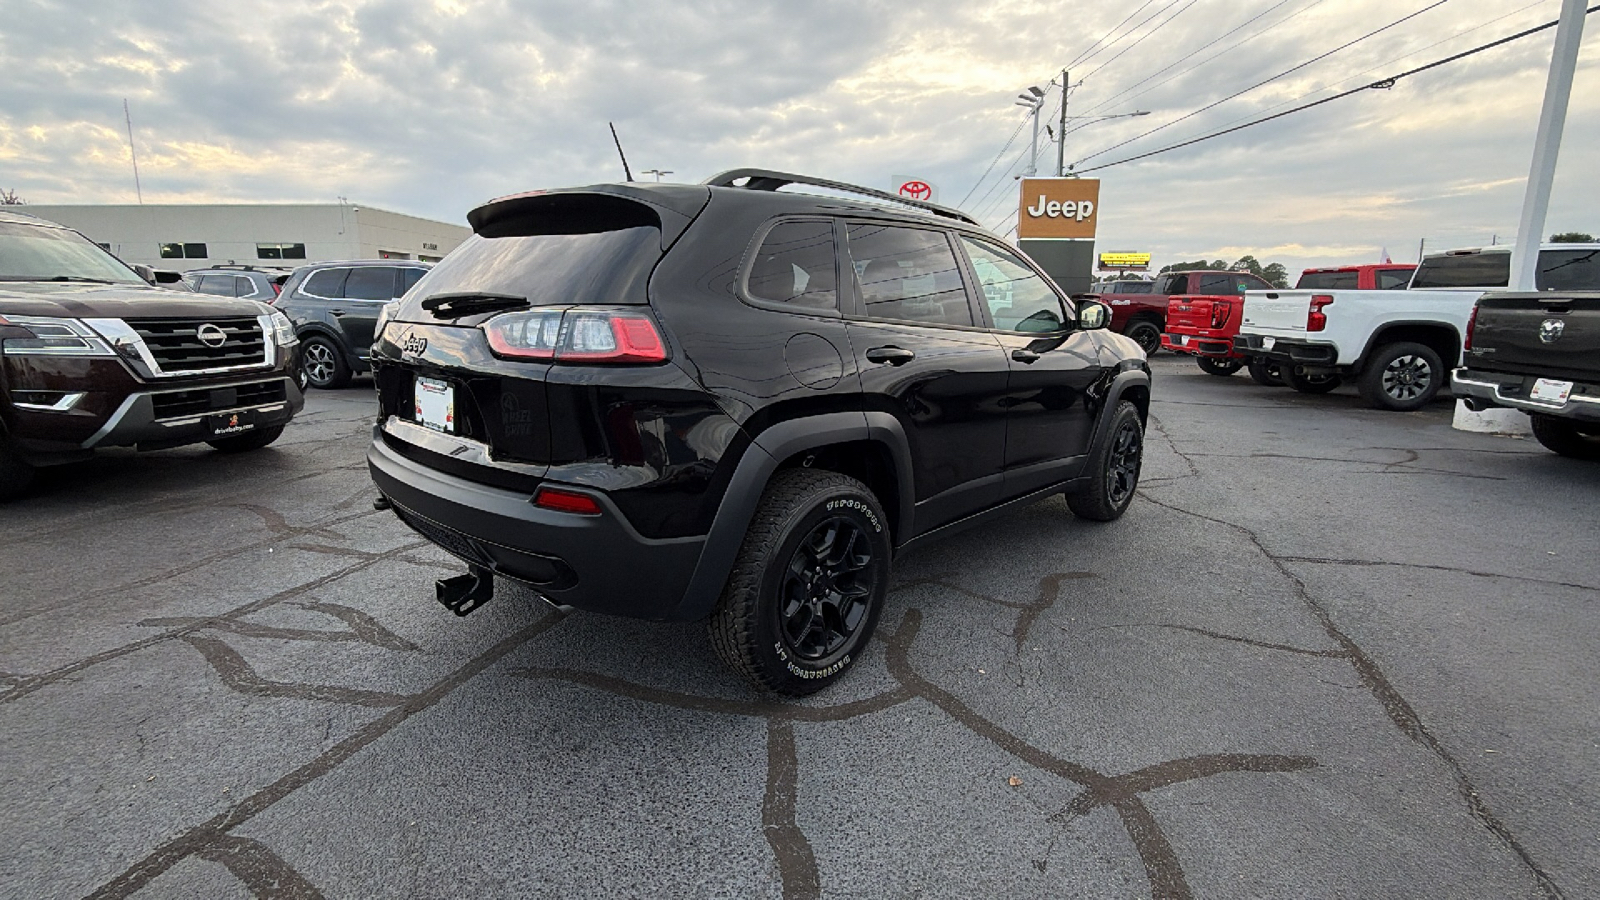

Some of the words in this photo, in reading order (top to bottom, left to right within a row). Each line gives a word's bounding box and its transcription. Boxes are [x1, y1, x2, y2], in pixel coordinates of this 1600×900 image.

[1027, 194, 1094, 222] Jeep
[402, 332, 428, 357] Jeep
[501, 409, 532, 425] WHEEL
[214, 424, 254, 434] drivebaby.com
